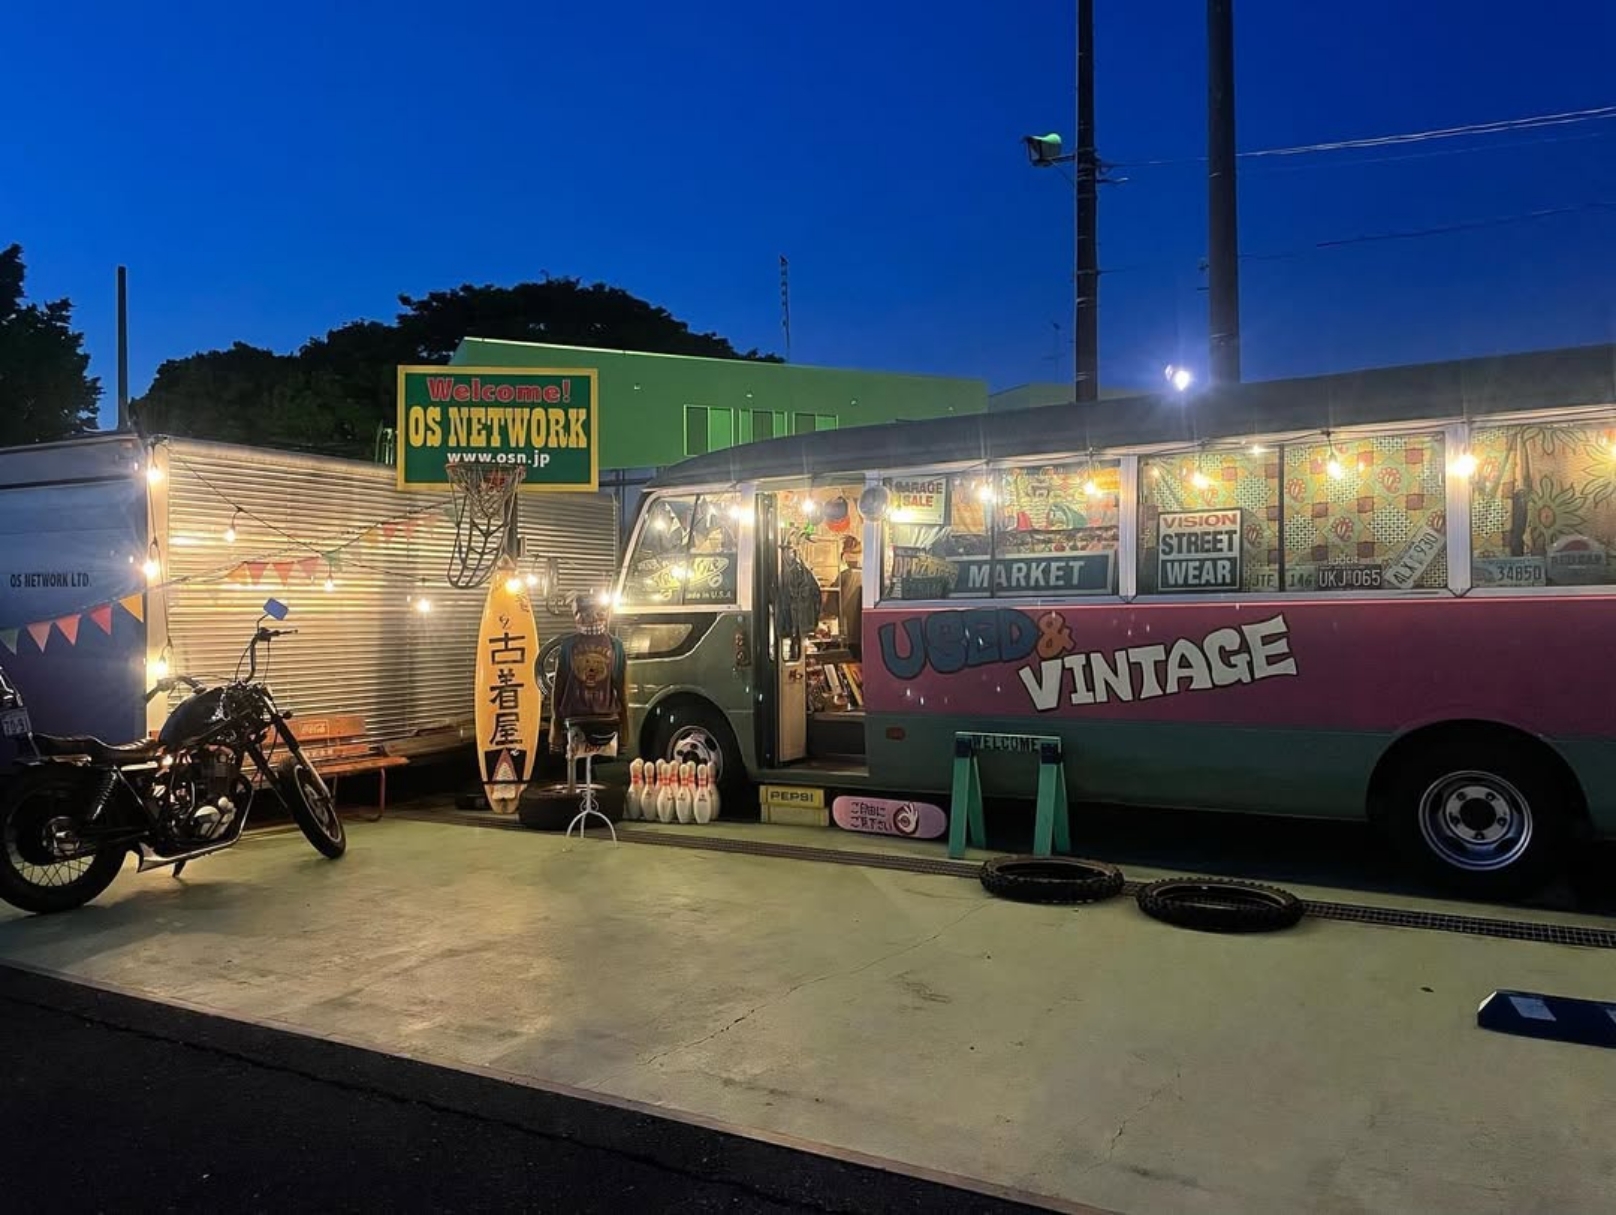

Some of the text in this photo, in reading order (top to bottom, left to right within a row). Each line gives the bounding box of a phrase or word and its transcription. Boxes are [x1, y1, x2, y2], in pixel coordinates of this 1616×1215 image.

[427, 377, 571, 403] Welcome!
[409, 406, 587, 448] OS NETWORK
[447, 450, 550, 467] www.osn.jp
[895, 479, 943, 495] GARAGE
[902, 495, 933, 508] SALE
[1162, 514, 1237, 529] VISION
[1161, 530, 1238, 556] STREET
[10, 574, 22, 588] OS
[24, 573, 68, 588] NETWORK
[967, 560, 1085, 589] MARKET
[1166, 558, 1232, 586] WEAR
[1319, 569, 1381, 587] UKJ 065
[878, 607, 1076, 680] USED &
[1018, 614, 1298, 712] VINTAGE
[488, 632, 526, 746] 古着屋
[970, 735, 1040, 752] WELCOME
[770, 790, 814, 803] PEPSI
